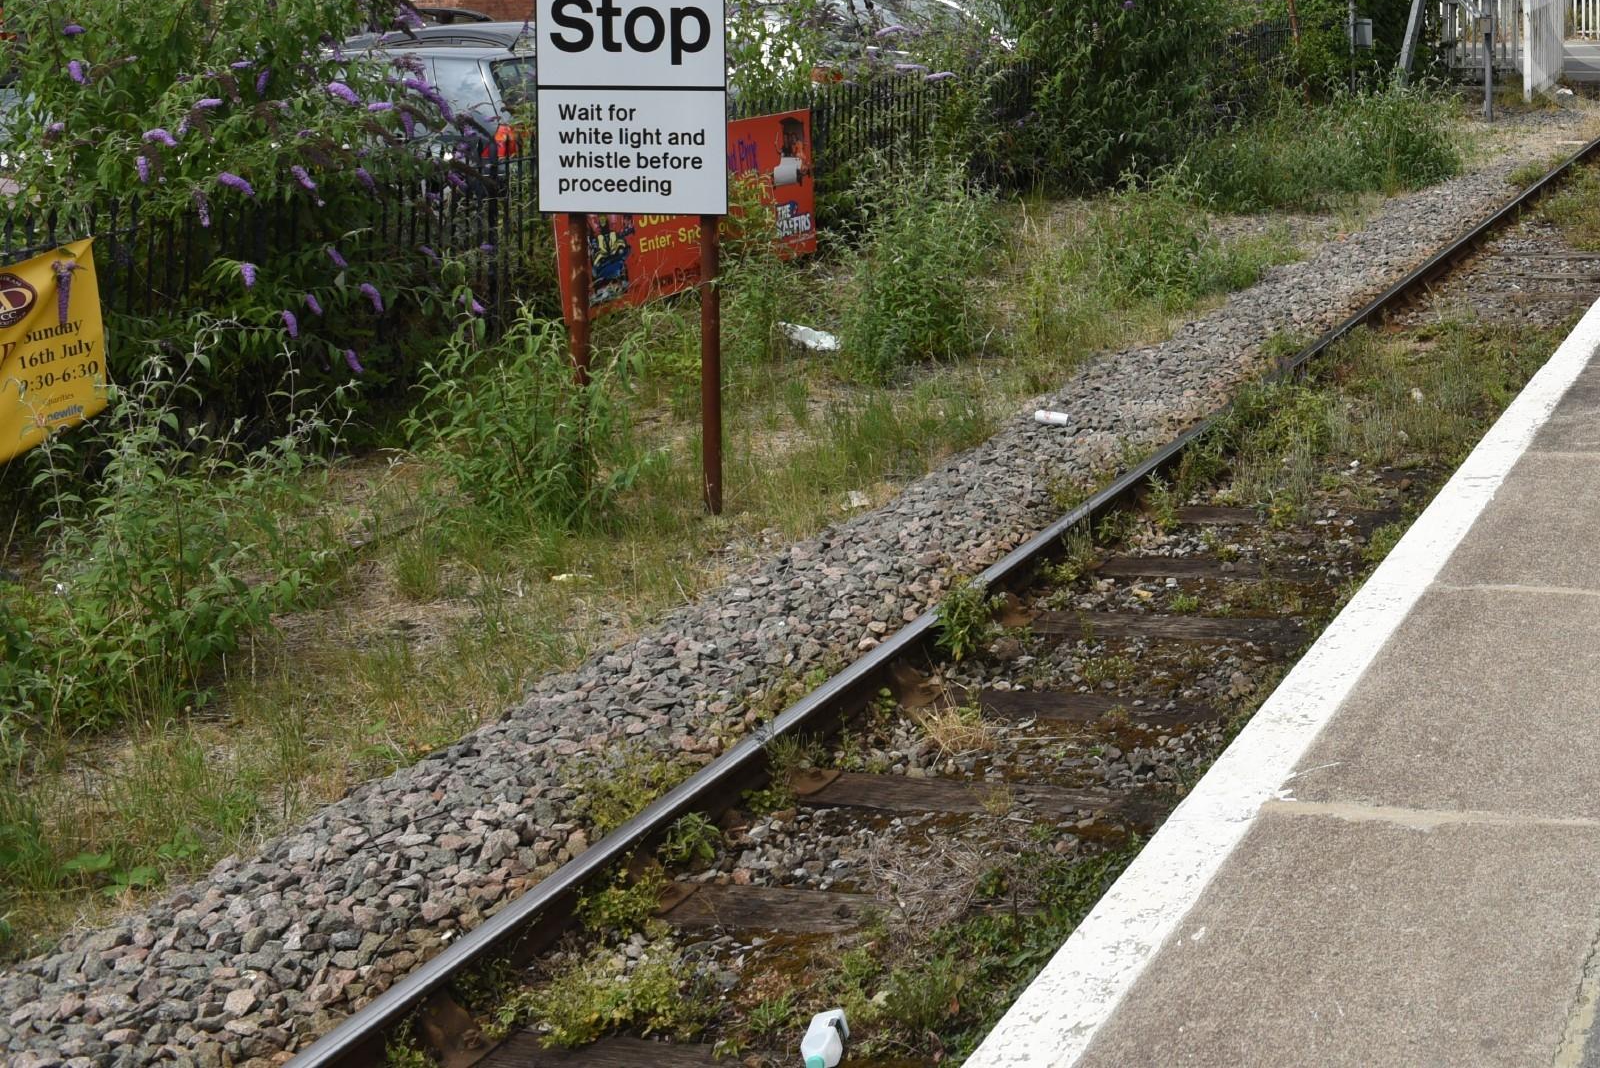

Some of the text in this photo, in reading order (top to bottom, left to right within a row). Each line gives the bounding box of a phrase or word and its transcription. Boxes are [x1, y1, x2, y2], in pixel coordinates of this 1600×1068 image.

[558, 104, 636, 122] Wait for
[559, 127, 705, 149] white light and
[559, 151, 703, 170] whistle before
[558, 176, 672, 197] proceeding
[639, 233, 675, 253] Enter,
[24, 319, 84, 344] Sunday
[18, 347, 55, 370] 16th
[60, 340, 95, 360] July
